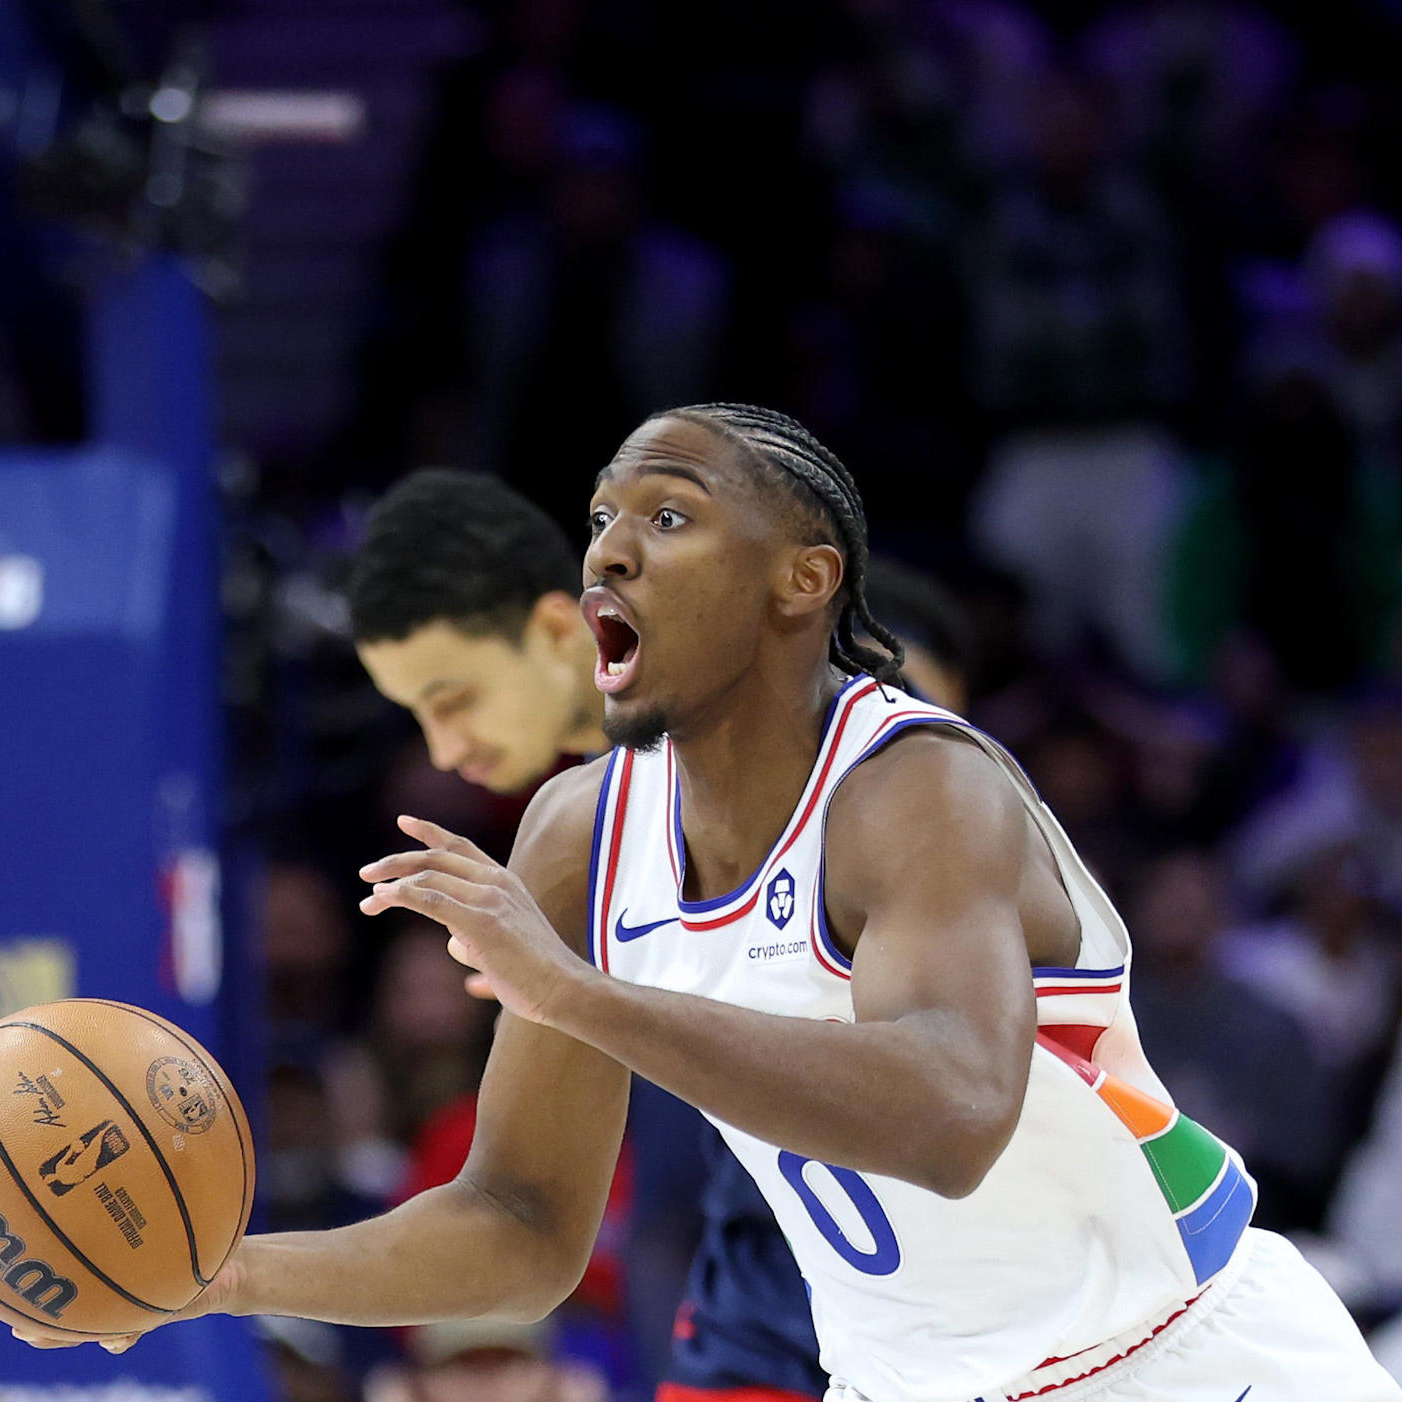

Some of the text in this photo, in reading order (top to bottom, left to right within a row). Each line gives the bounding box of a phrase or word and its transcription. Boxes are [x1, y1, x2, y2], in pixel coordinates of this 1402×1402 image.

[748, 939, 808, 961] crypto.com
[92, 1181, 115, 1205] BALL
[104, 1198, 127, 1223] GAME
[778, 1148, 901, 1276] 0
